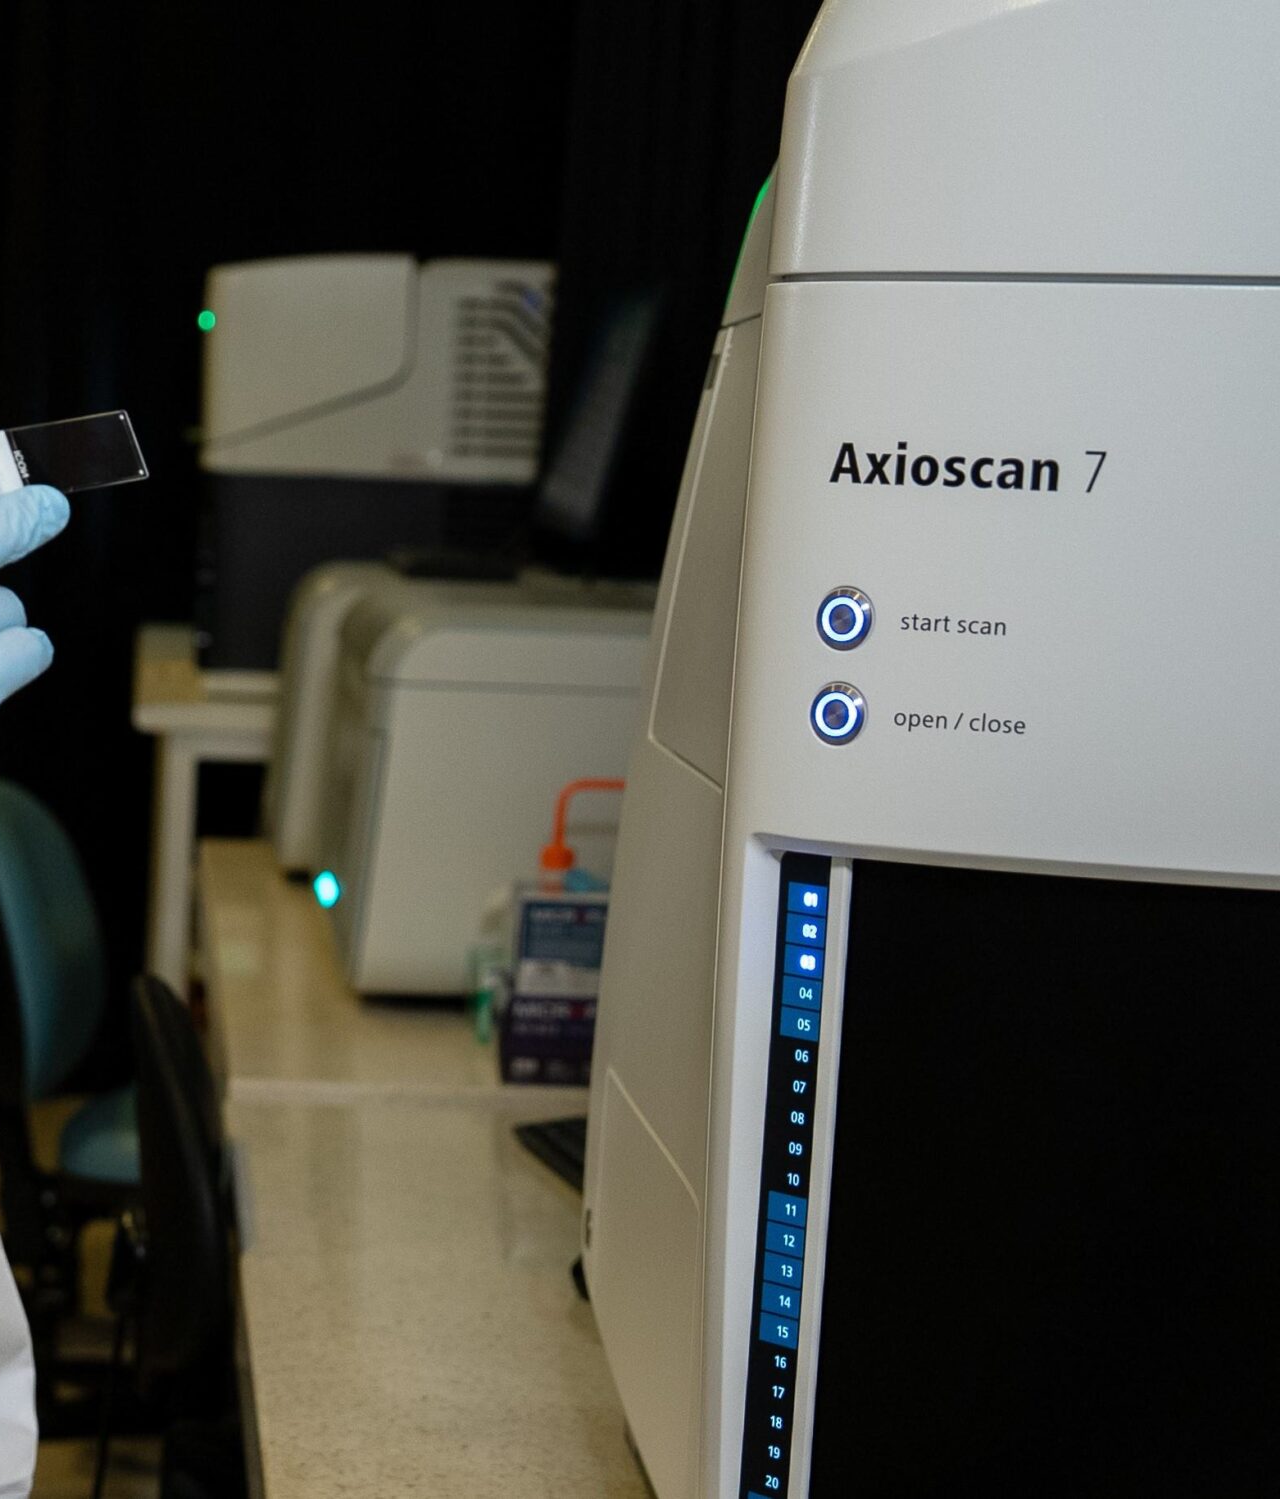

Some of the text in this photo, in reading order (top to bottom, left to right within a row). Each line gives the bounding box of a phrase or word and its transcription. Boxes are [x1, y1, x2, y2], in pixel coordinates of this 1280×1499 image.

[829, 441, 1107, 494] Axioscan 7
[900, 613, 1007, 636] start scan
[893, 712, 948, 733] open
[969, 712, 1026, 735] close
[803, 891, 819, 908] 01
[802, 923, 818, 939] 02
[799, 954, 816, 971] 03
[798, 986, 813, 1001] 04
[797, 1017, 811, 1032] 05
[794, 1048, 809, 1063] 06
[792, 1079, 807, 1094] 07
[790, 1110, 805, 1125] 08
[788, 1141, 803, 1156] 09
[787, 1172, 800, 1187] 10
[785, 1203, 797, 1217] 11
[783, 1234, 795, 1248] 12
[781, 1264, 793, 1278] 13
[779, 1294, 791, 1309] 14
[776, 1324, 789, 1339] 15
[774, 1355, 787, 1369] 16
[772, 1385, 785, 1399] 17
[770, 1415, 783, 1430] 18
[767, 1445, 781, 1459] 19
[765, 1474, 779, 1490] 20
